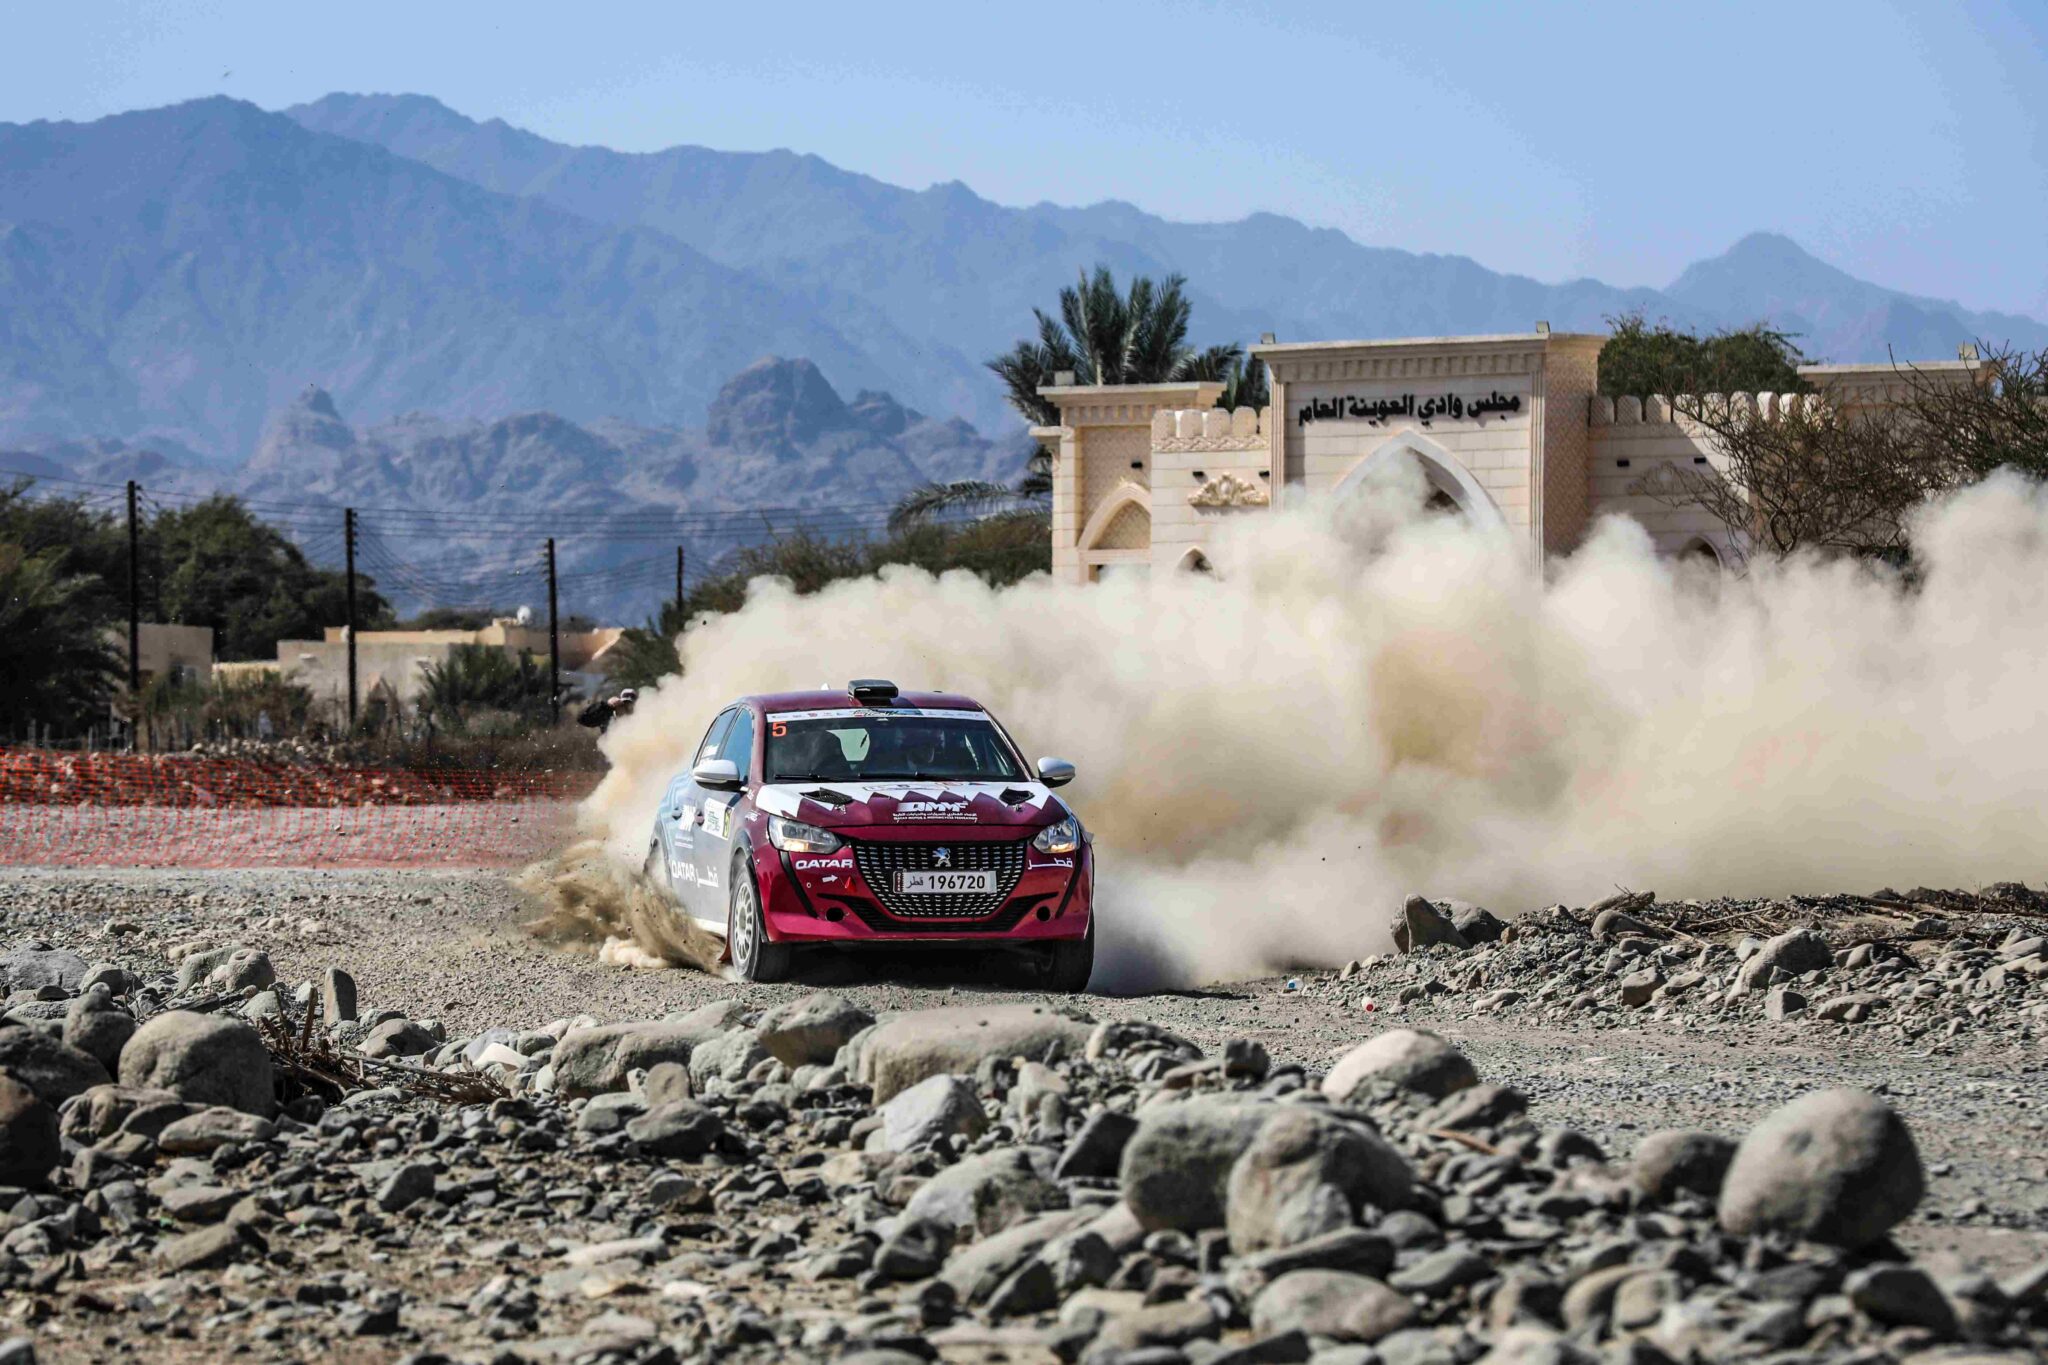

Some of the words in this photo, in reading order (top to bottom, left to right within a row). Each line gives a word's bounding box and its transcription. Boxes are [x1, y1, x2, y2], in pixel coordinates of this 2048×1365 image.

[1299, 397, 1344, 426] العام
[1349, 394, 1414, 427] العوينة
[1418, 392, 1463, 426] وادي
[1467, 390, 1520, 421] مجلس
[771, 721, 787, 737] 5
[671, 860, 696, 882] QATAR
[795, 858, 854, 870] QATAR
[1027, 857, 1073, 870] قطر
[906, 875, 924, 888] قطر
[928, 875, 985, 889] 196720
